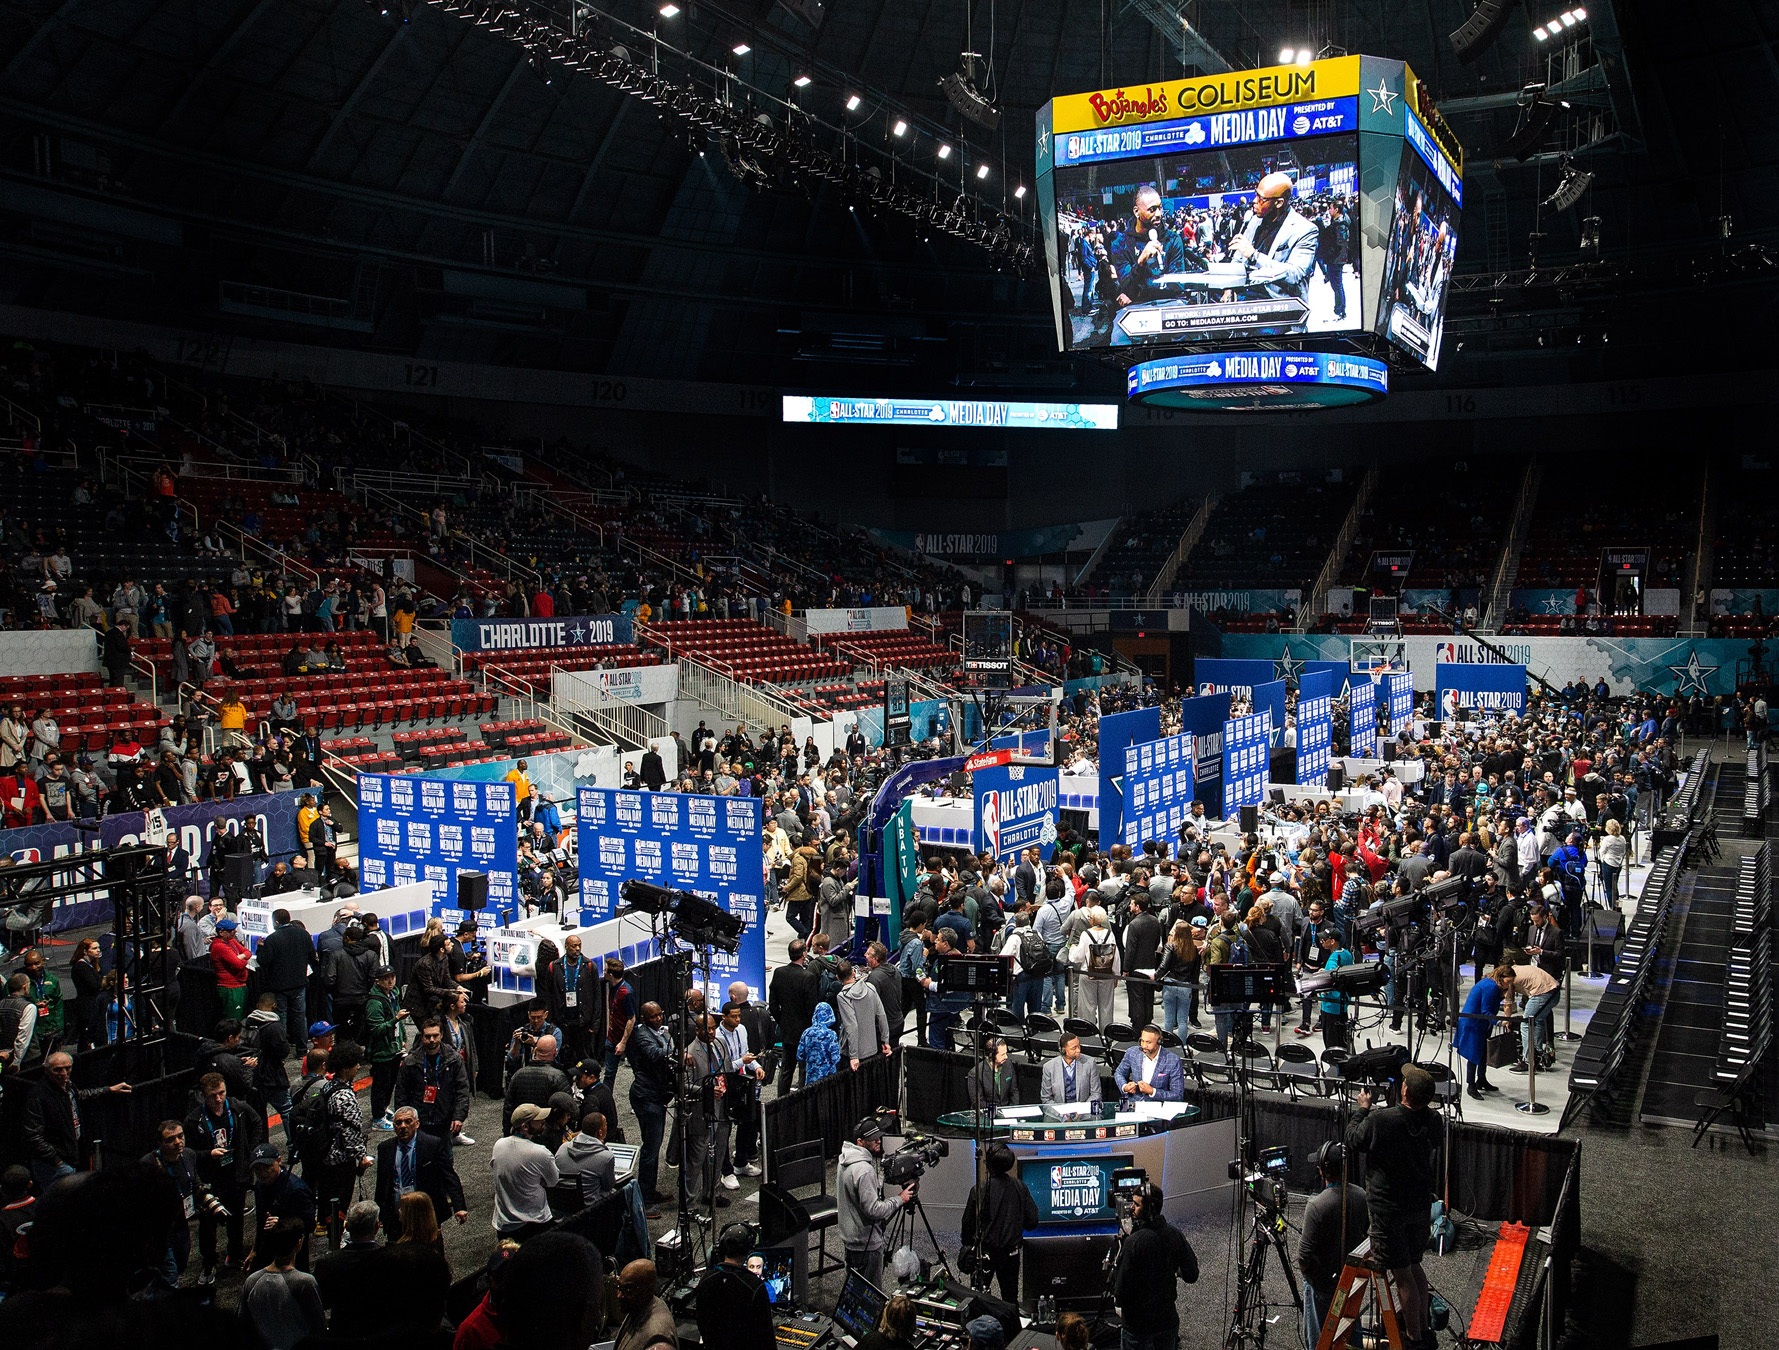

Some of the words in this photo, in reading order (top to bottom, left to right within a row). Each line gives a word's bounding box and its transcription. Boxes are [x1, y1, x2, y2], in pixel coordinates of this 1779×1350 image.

[1178, 70, 1315, 110] COLISEUM
[1294, 103, 1326, 114] PRESENTED
[1327, 102, 1335, 110] BY
[1210, 110, 1255, 144] MEDIA
[1258, 107, 1287, 138] DAY
[1312, 115, 1343, 130] AT&T
[1121, 131, 1142, 151] 2019
[1145, 132, 1184, 142] CHARLOTTE
[1225, 357, 1259, 379] MEDIA
[1261, 356, 1282, 379] DAY
[1299, 366, 1319, 375] AT&T
[875, 403, 893, 419] 2019
[949, 401, 985, 424] MEDIA
[986, 402, 1008, 425] DAY
[974, 534, 998, 554] 2019
[479, 622, 566, 649] CHARLOTTE
[590, 620, 613, 643] 2019
[1507, 644, 1531, 665] 2019
[977, 661, 1009, 670] TISSOT
[1501, 691, 1522, 709] 2019
[1039, 778, 1057, 810] 2019
[152, 815, 162, 829] 15
[1003, 826, 1039, 846] CHARLOTTE
[516, 930, 526, 938] WADE
[1051, 1190, 1080, 1207] MEDIA
[1082, 1188, 1100, 1206] DAY
